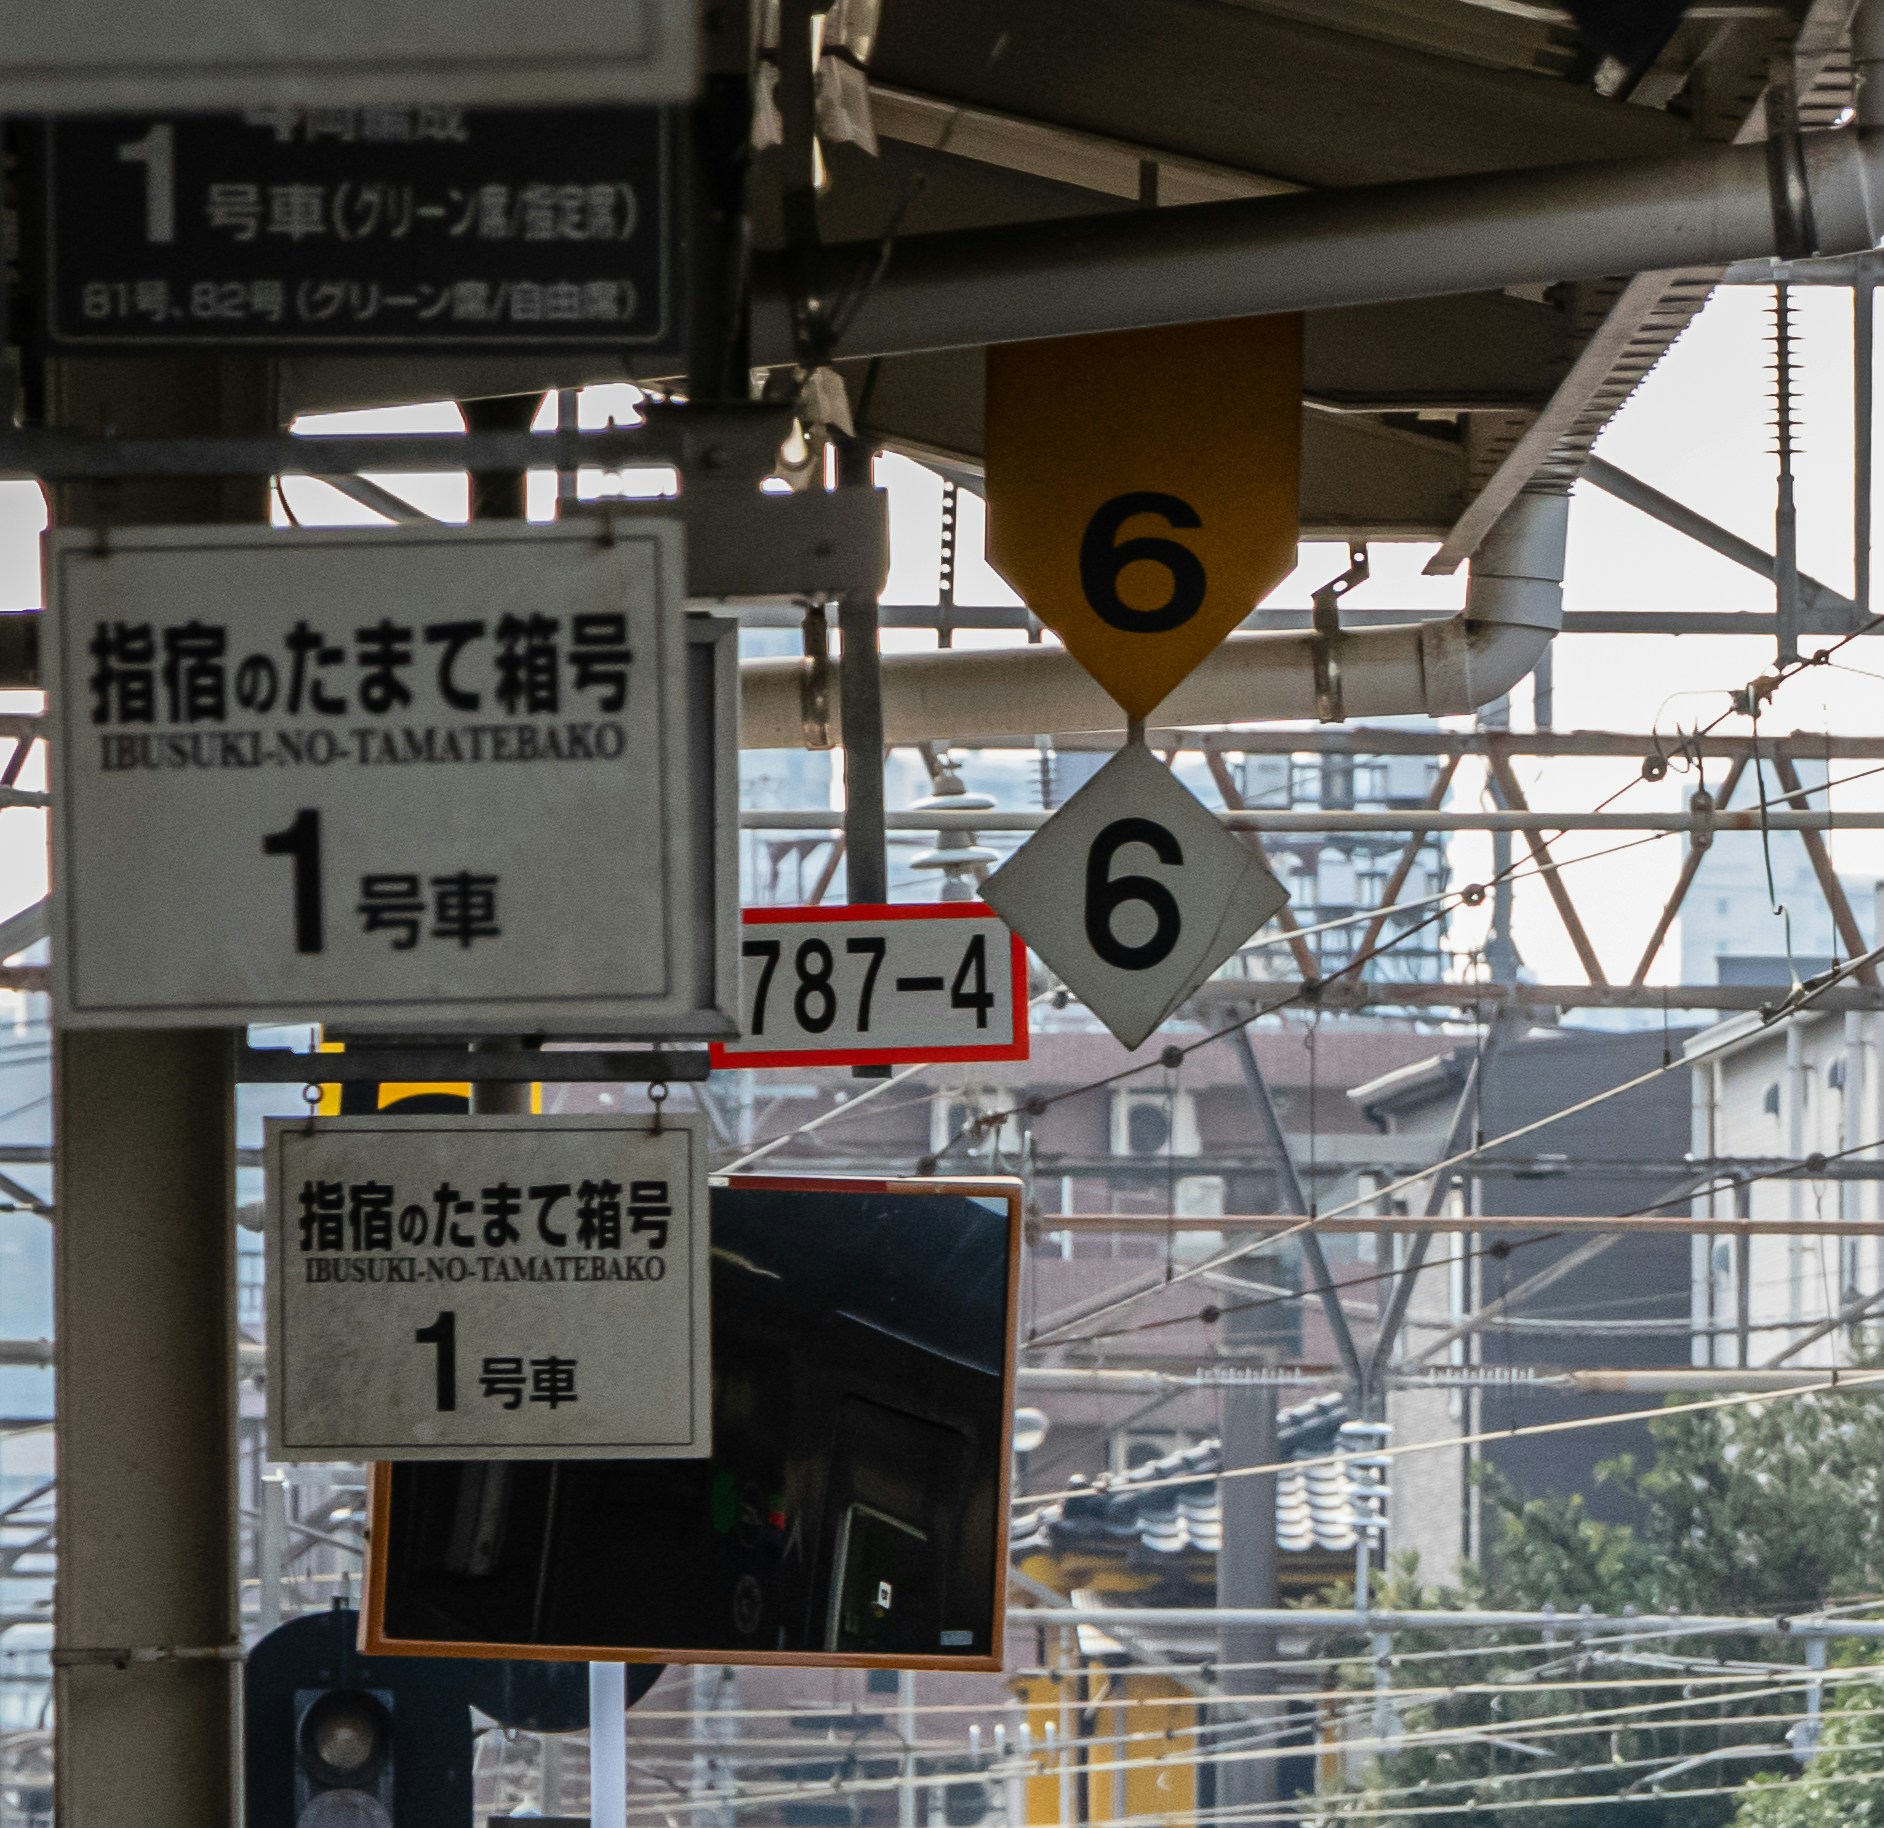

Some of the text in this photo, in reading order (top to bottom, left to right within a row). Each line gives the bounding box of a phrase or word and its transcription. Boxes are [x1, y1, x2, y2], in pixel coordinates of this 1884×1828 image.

[1079, 490, 1206, 633] 6
[89, 613, 633, 725] 指宿のたまて箱号
[99, 722, 626, 772] IBUSUKI-NO-TAMATEBAKO
[1085, 817, 1184, 971] 6
[742, 934, 995, 1035] 787-4
[298, 1180, 672, 1250] 指宿のたまて箱号
[304, 1256, 666, 1284] IBUSUKI-NO-TAMATEBAKO
